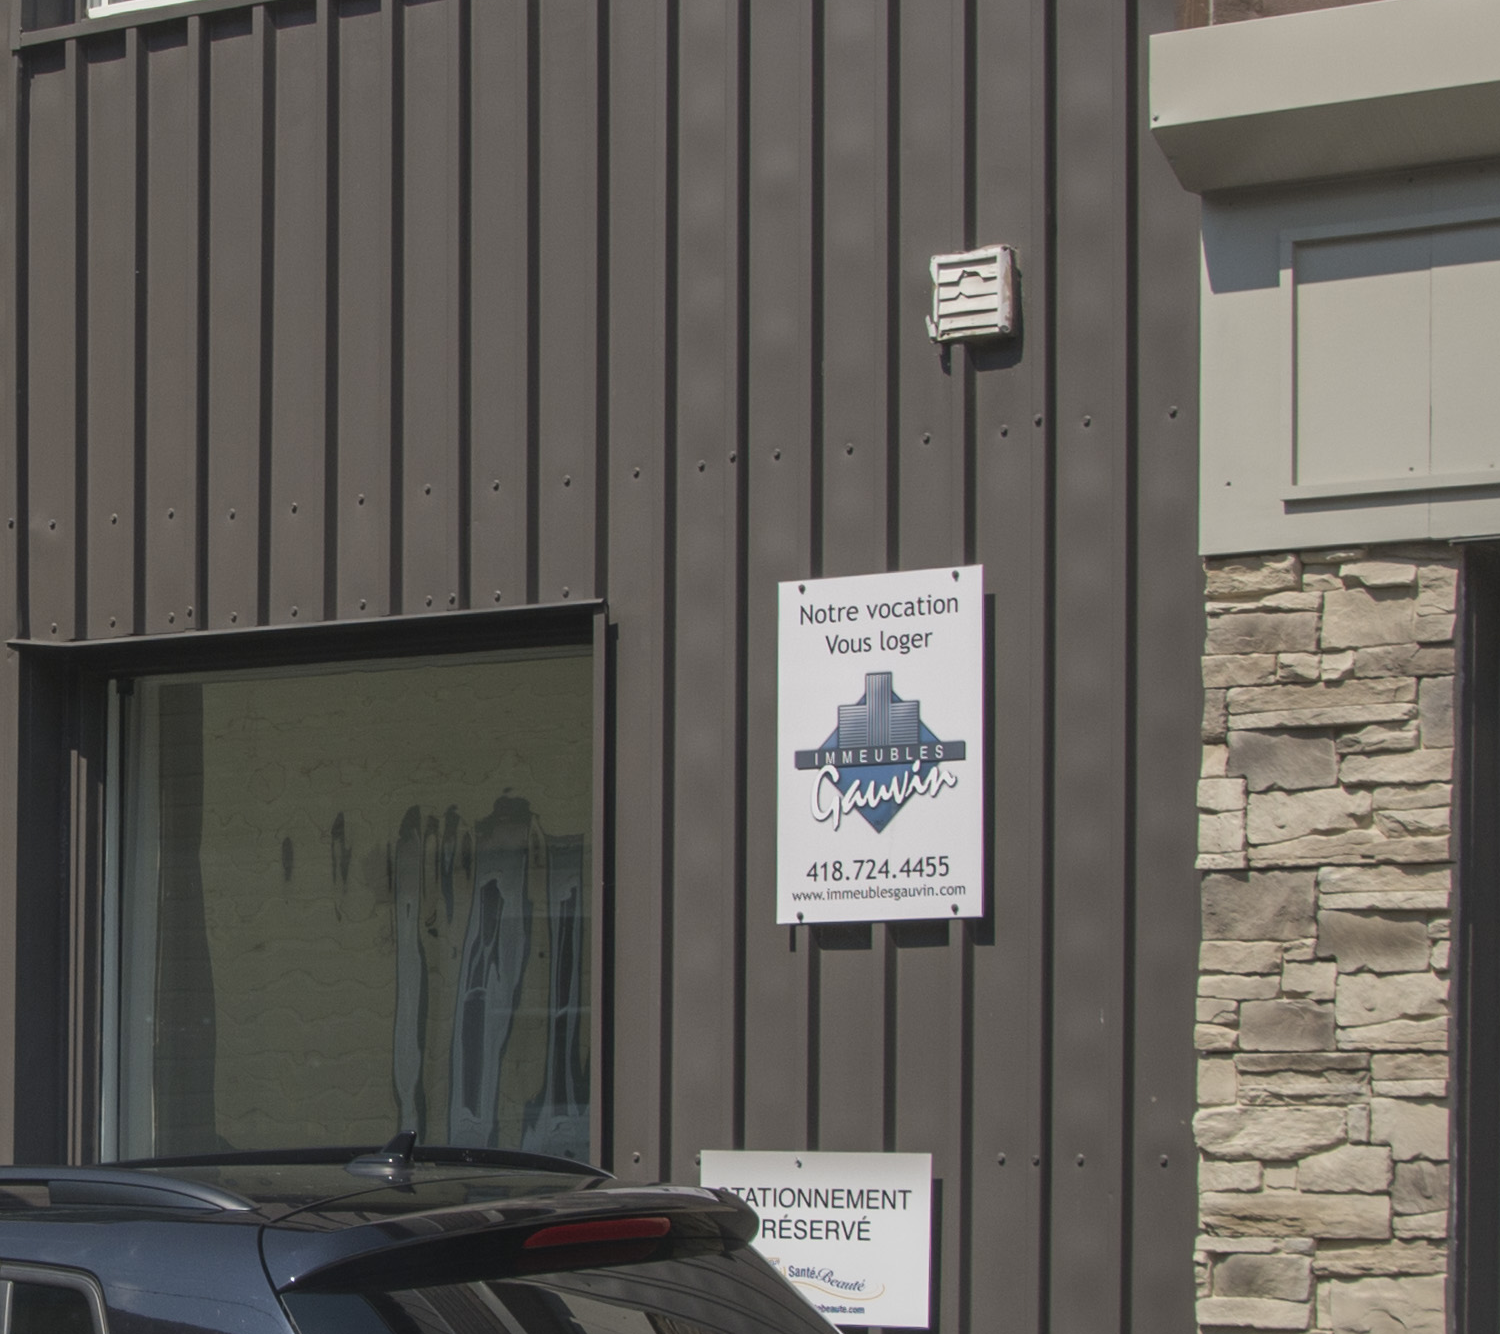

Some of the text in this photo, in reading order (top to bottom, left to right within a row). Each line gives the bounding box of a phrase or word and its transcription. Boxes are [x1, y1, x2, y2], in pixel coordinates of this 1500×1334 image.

[800, 596, 959, 625] Notre vocation
[826, 630, 933, 654] Vous loger
[814, 744, 944, 765] IMMEUBLES
[811, 760, 958, 832] Gauvin
[806, 856, 950, 883] 418.724.4455
[792, 883, 966, 903] www.immeublesgauvin.com
[719, 1187, 912, 1210] TATIONNEMENT
[761, 1214, 872, 1241] RÉSERVÉ
[788, 1265, 815, 1279] Santé
[815, 1268, 866, 1292] Beauté
